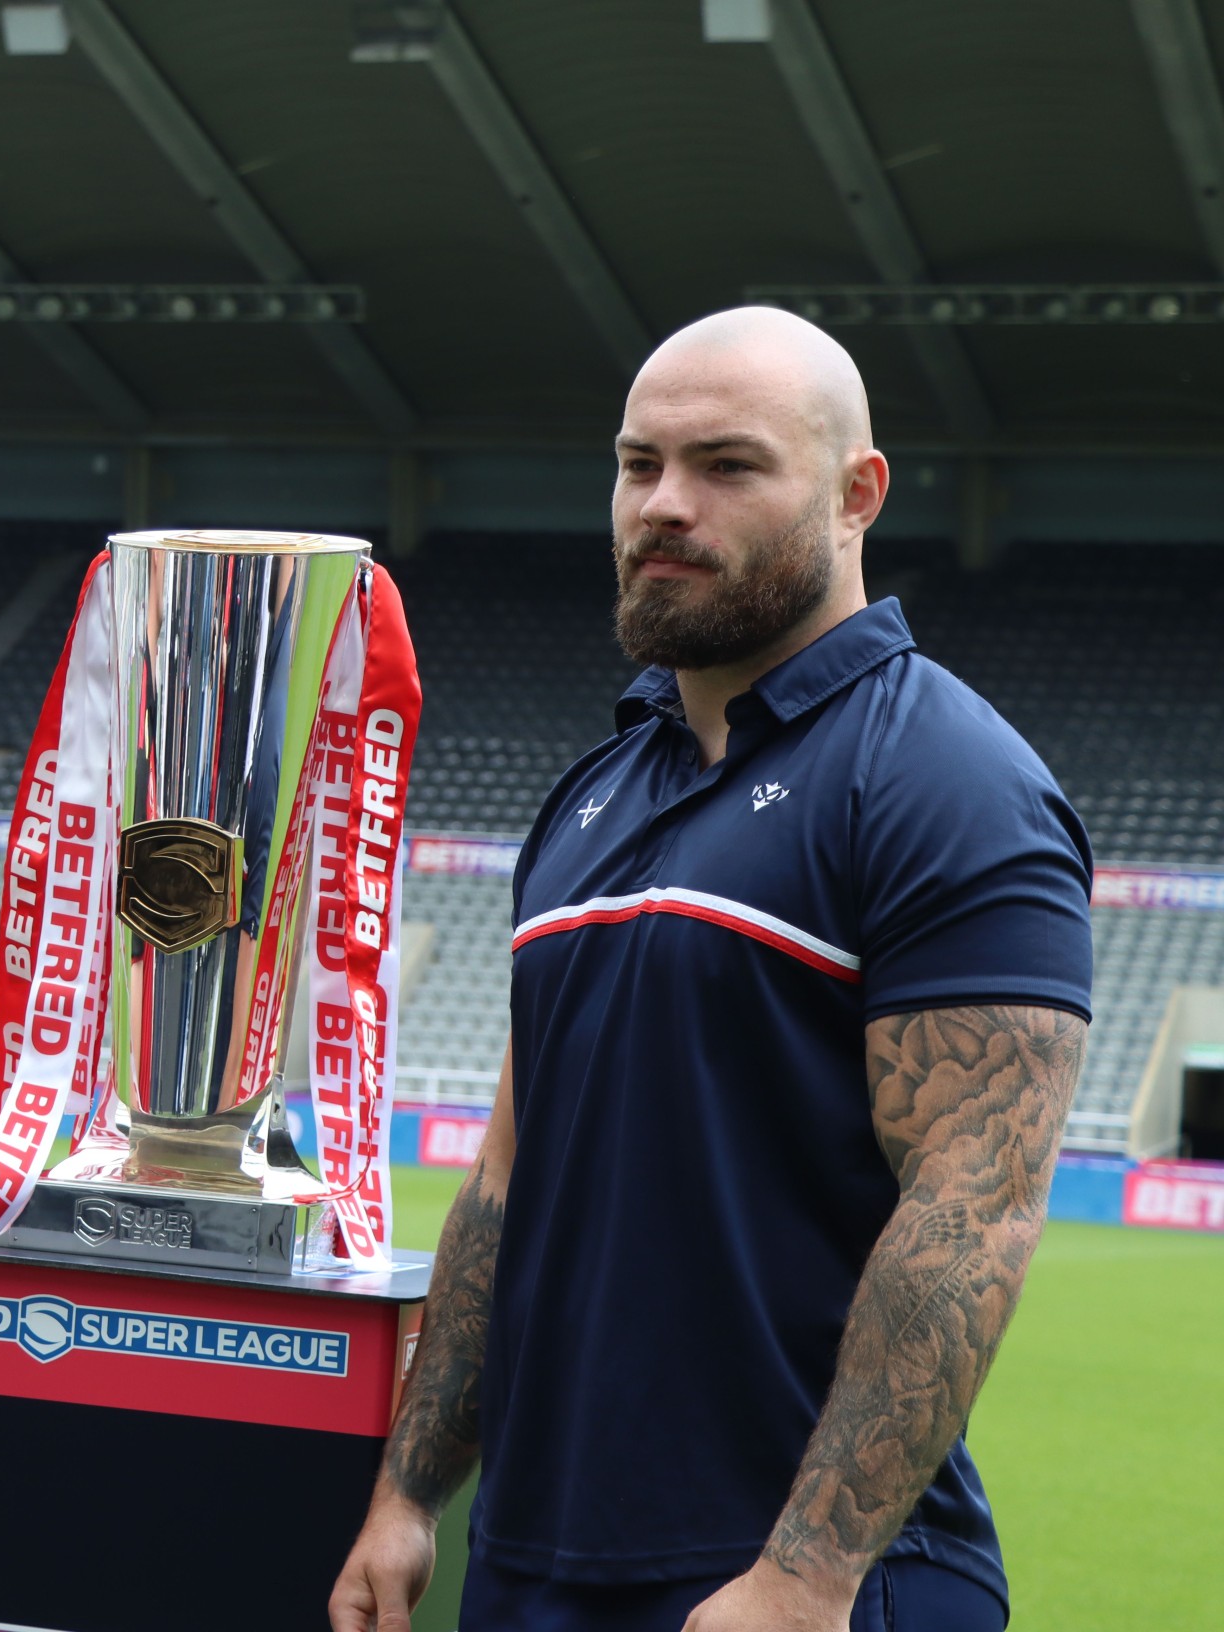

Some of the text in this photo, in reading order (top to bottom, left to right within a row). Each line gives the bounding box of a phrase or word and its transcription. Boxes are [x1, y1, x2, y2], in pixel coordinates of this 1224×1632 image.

[5, 749, 59, 982] BETFRED
[355, 708, 404, 950] BETFRED
[31, 801, 96, 1056] BETFRED
[119, 1226, 191, 1249] LEAGUE
[120, 1206, 192, 1233] SUPER
[80, 1313, 187, 1353] SUPER
[195, 1325, 340, 1369] LEAGUE
